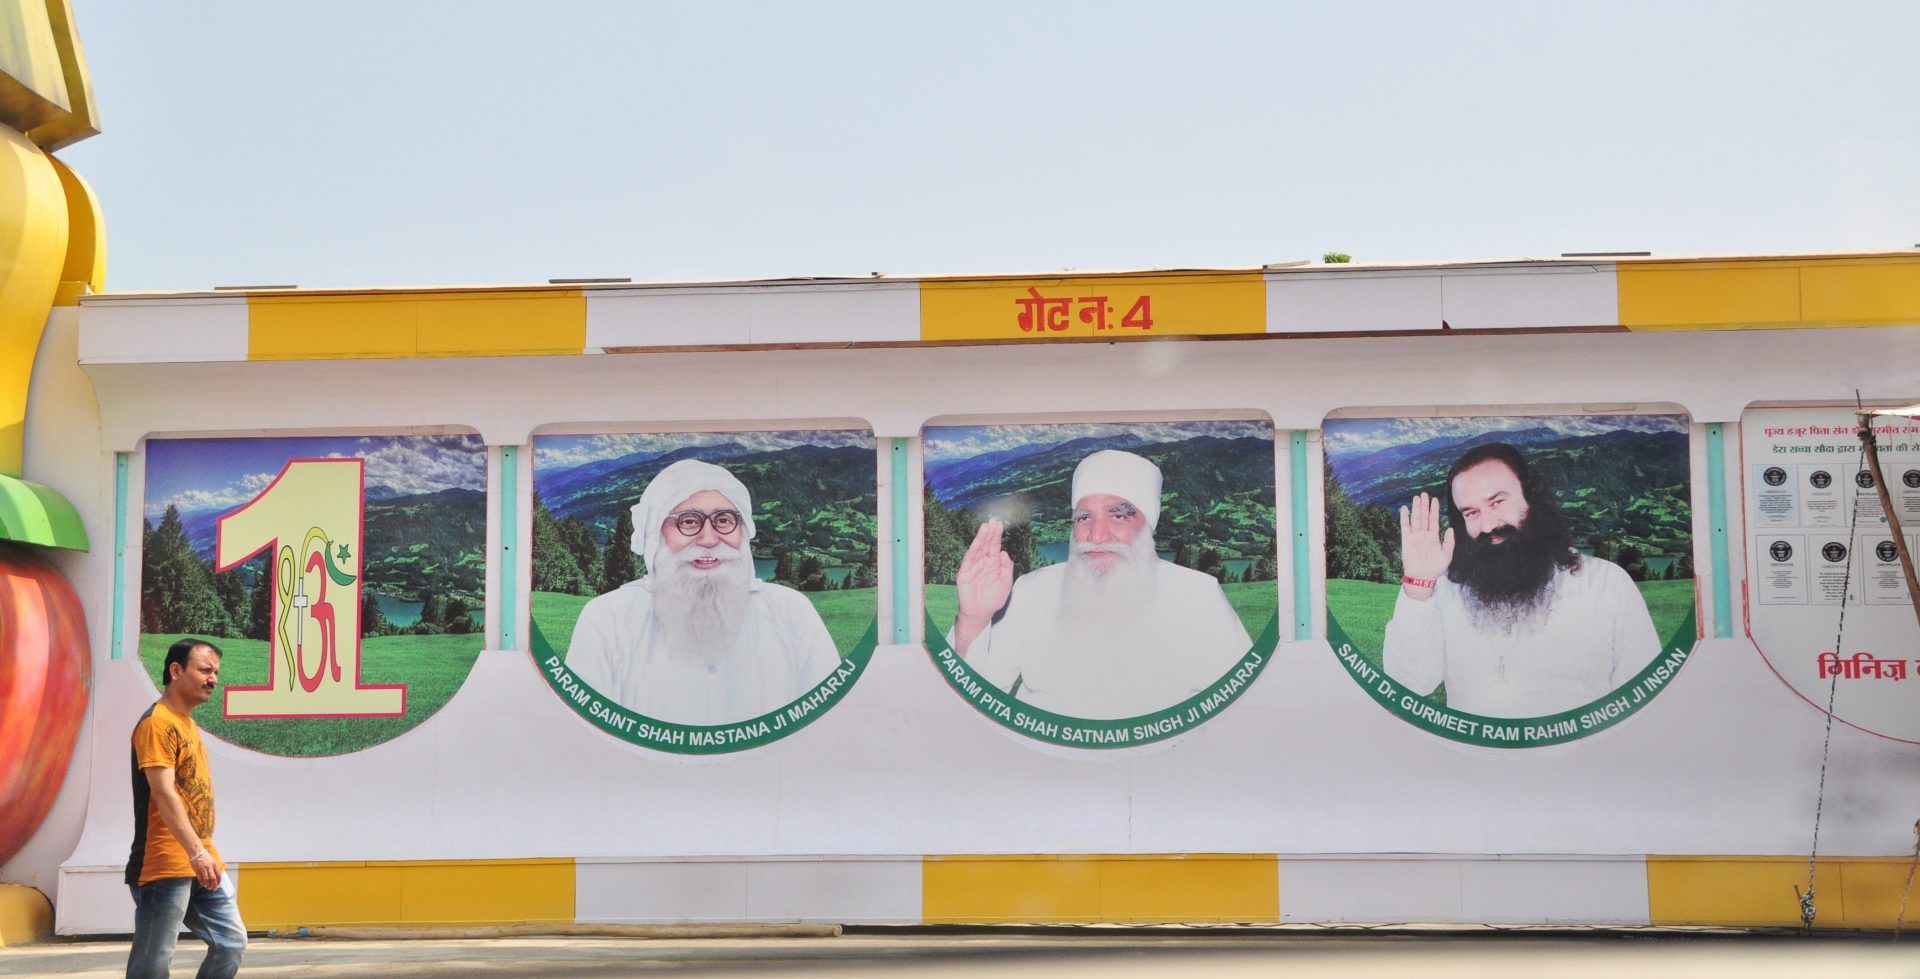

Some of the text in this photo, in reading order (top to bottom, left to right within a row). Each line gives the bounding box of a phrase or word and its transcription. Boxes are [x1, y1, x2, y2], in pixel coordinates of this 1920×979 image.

[1015, 286, 1073, 332] गेट
[1121, 295, 1153, 330] 4
[1809, 425, 1830, 435] पिता
[545, 655, 857, 746] PARAM SAINT SHAH MASTANA JI MAHARAJ
[938, 648, 1263, 743] PARAM PITA SHAH SATNAM SINGH JI MAHARAJ
[1338, 642, 1687, 741] SAINT Dr. GURMEET RAM RAHIM SINGH JI INSAN
[1817, 652, 1907, 682] गिनिज़
